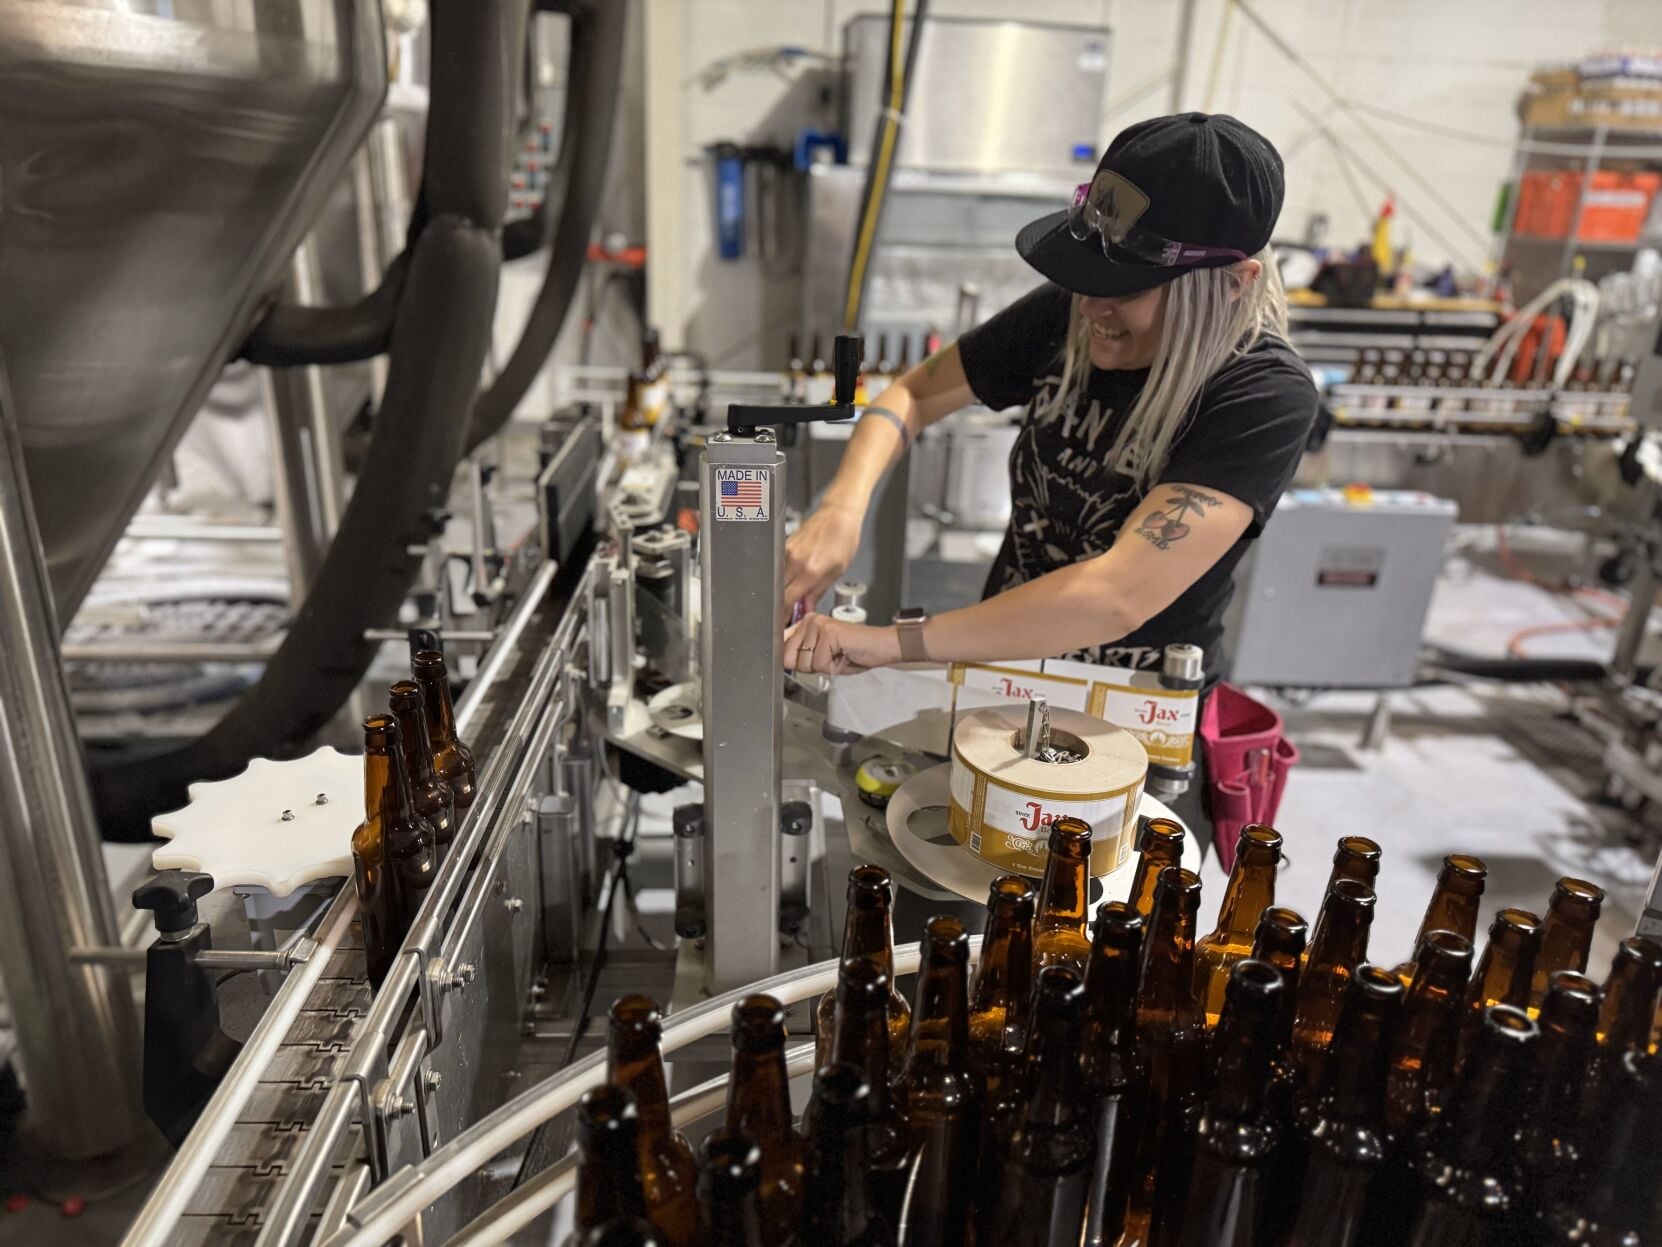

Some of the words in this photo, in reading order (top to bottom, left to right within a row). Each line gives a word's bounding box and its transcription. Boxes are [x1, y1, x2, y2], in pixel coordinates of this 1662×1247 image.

[717, 470, 752, 480] MADE
[756, 470, 767, 480] IN
[717, 506, 729, 517] U.
[736, 506, 747, 517] S.
[756, 506, 768, 517] A.
[995, 677, 1034, 701] Jax
[1139, 699, 1180, 725] Jax
